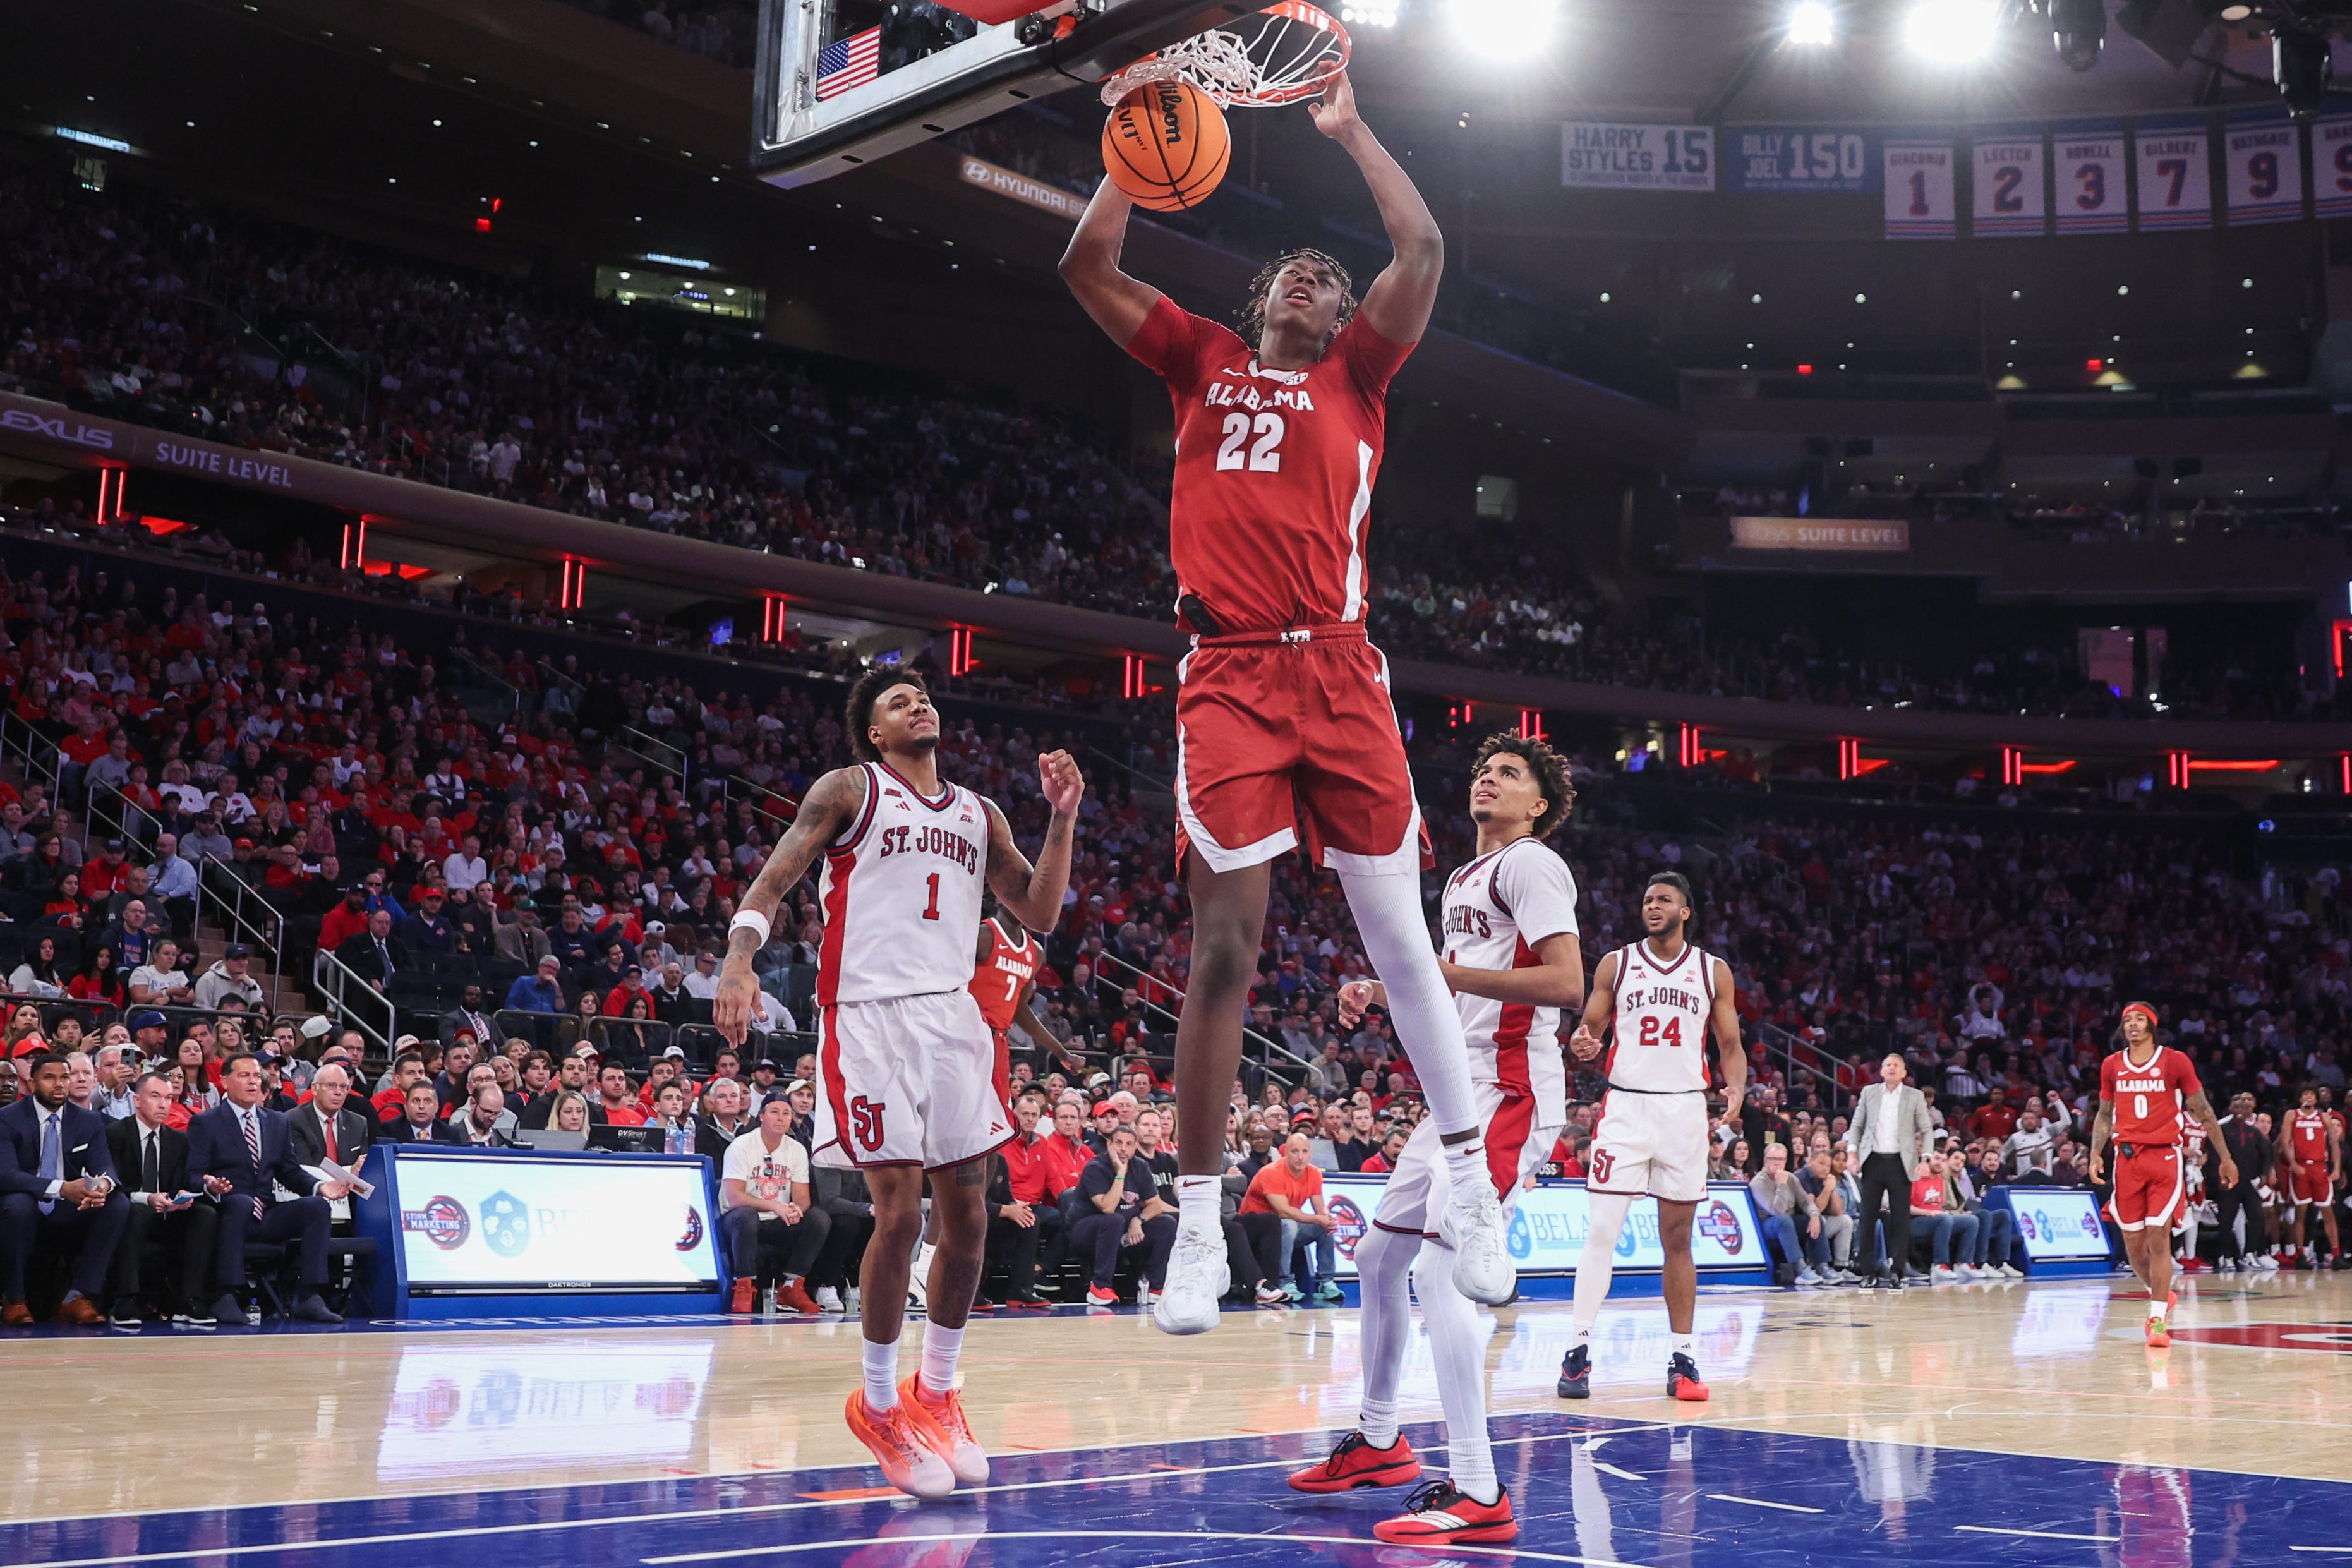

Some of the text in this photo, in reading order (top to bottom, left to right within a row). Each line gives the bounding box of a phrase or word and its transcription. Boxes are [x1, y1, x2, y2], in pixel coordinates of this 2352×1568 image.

[1574, 128, 1645, 148] HARRY
[1664, 130, 1708, 173] 15
[1569, 148, 1653, 172] STYLES
[1789, 134, 1864, 178] 150
[994, 171, 1066, 210] HYUNDAI
[1994, 166, 2023, 212] 2
[2074, 162, 2106, 210] 3
[2156, 159, 2187, 207] 7
[2248, 151, 2279, 199] 9
[1908, 169, 1930, 216] 1
[1205, 382, 1315, 411] ALABAMA
[1215, 412, 1285, 473] 22
[156, 442, 221, 474] SUITE
[227, 457, 292, 488] LEVEL
[1798, 527, 1845, 542] SUITE
[1851, 528, 1902, 543] LEVEL
[881, 826, 978, 876] ST. JOHN'S
[922, 872, 940, 920] 1
[1445, 905, 1492, 938] JOHN'S
[995, 955, 1033, 980] ALABAMA
[1004, 974, 1018, 1001] 7
[1627, 987, 1699, 1015] ST. JOHN'S
[1639, 1016, 1682, 1046] 24
[2116, 1079, 2166, 1092] ALABAMA
[2134, 1094, 2148, 1119] 0
[406, 1212, 427, 1221] STORM
[410, 1220, 461, 1229] MARKETING
